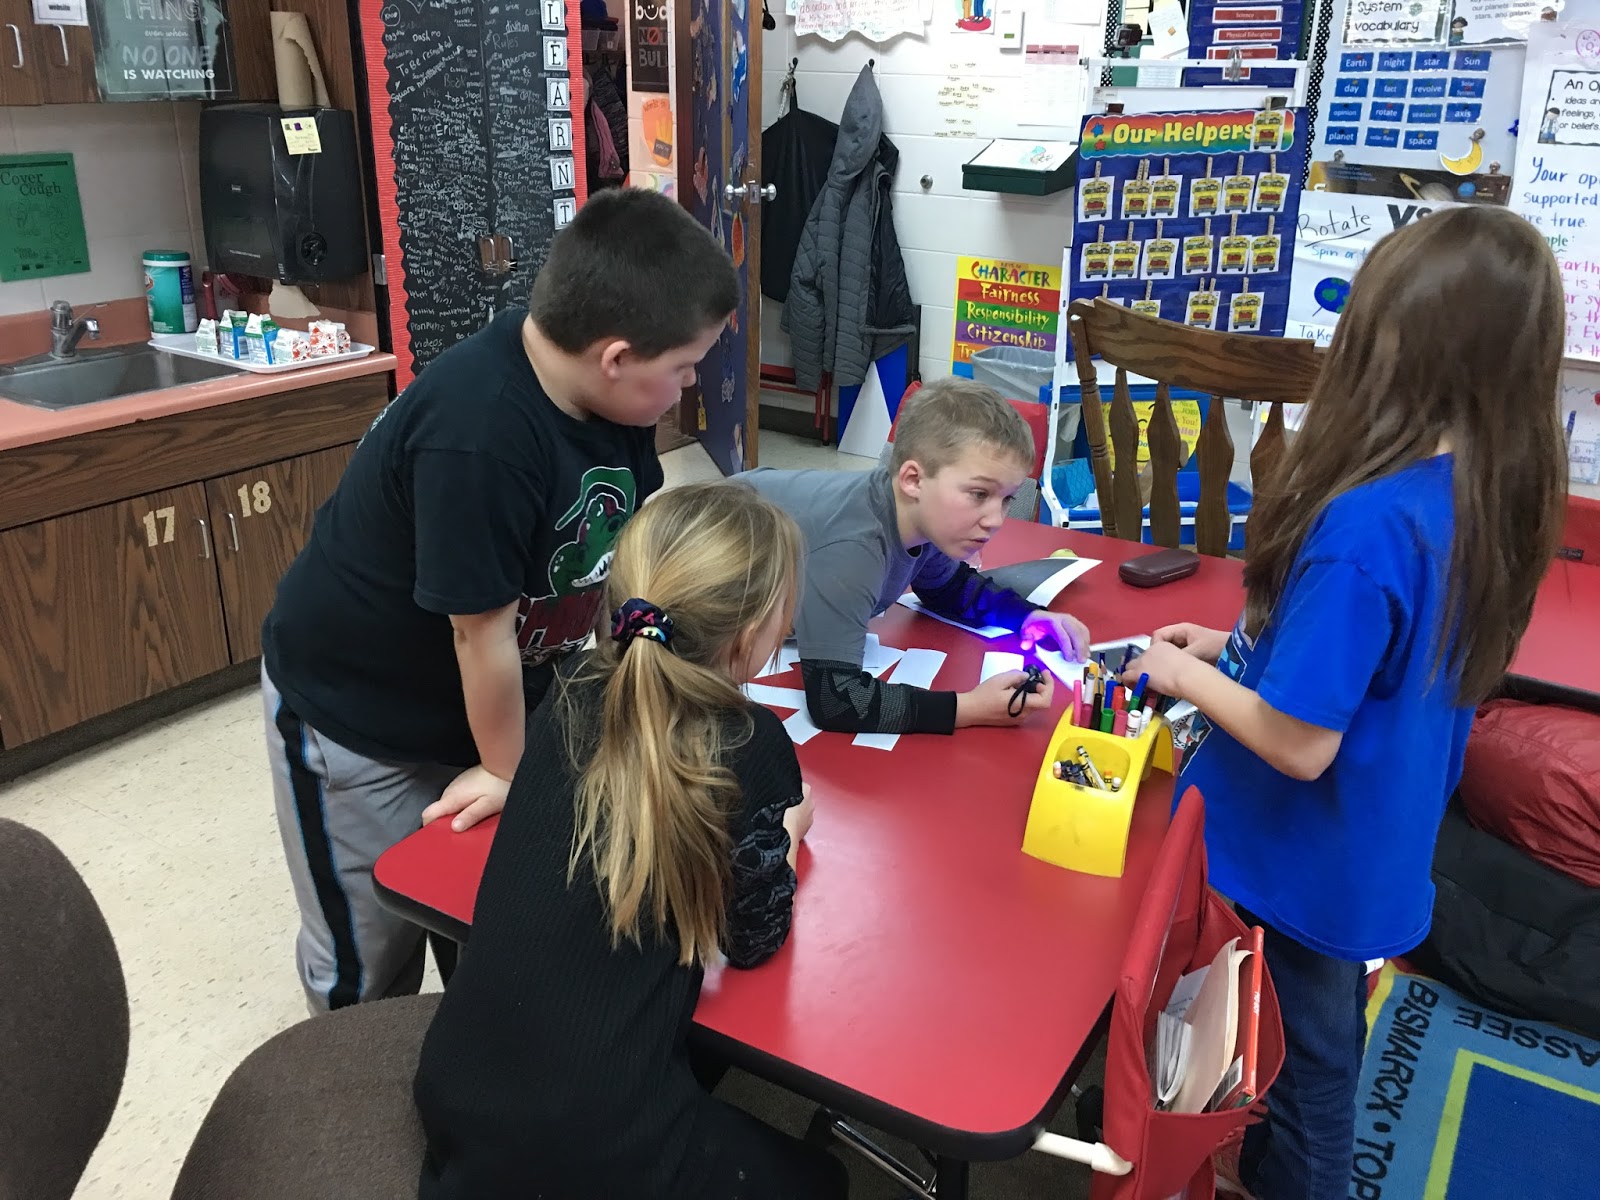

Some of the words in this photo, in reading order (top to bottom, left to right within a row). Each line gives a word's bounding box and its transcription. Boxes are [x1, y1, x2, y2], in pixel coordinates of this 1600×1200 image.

[1354, 19, 1420, 34] vocabulary
[1247, 31, 1273, 39] Education
[122, 46, 158, 66] NO
[166, 46, 211, 66] ONE
[1345, 59, 1367, 67] Earth
[1383, 58, 1405, 68] night
[1423, 58, 1440, 66] star
[1464, 57, 1481, 65] Sun
[124, 70, 137, 79] IS
[141, 69, 215, 80] WATCHING
[1344, 84, 1359, 94] day
[1414, 85, 1442, 93] revolve
[1564, 78, 1583, 90] An
[1565, 96, 1587, 105] ideas
[1333, 110, 1357, 118] opinion
[1454, 109, 1471, 117] axis
[1113, 123, 1157, 144] Our
[1163, 121, 1253, 147] Helpers
[1328, 132, 1354, 142] planet
[1408, 137, 1433, 146] space
[1529, 156, 1568, 184] Your
[0, 171, 43, 185] Cover
[20, 181, 61, 197] Cough
[1297, 205, 1372, 238] Rotate
[1311, 245, 1339, 260] Spin
[1345, 250, 1358, 259] or
[971, 261, 1051, 287] CHARACTER
[980, 282, 1040, 305] Fairness
[966, 301, 1050, 330] Responsibility
[967, 323, 1047, 349] Citizenship
[237, 480, 272, 518] 18
[143, 506, 175, 547] 17
[1366, 979, 1440, 1121] BISMARCK
